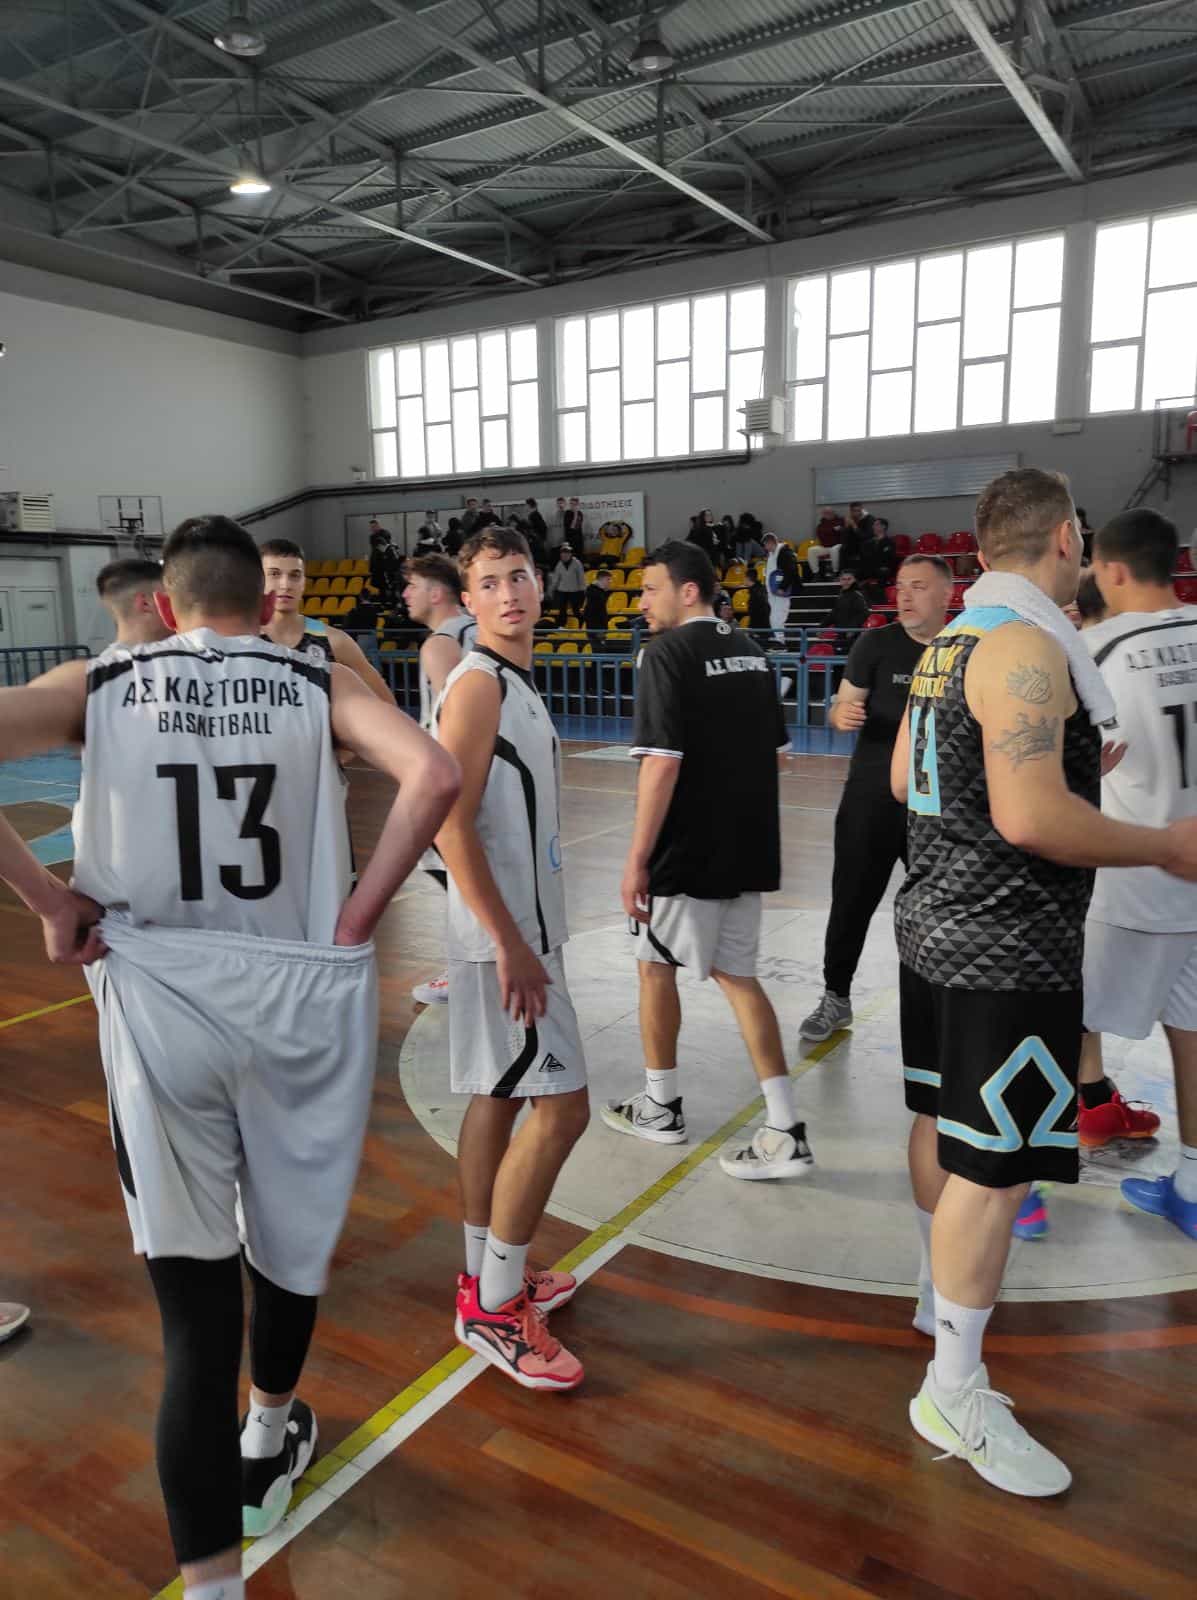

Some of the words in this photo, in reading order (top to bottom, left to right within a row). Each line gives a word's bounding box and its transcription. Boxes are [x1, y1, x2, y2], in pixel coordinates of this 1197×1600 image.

[165, 676, 304, 708] ΚΑΣΤΟΡΙΑΣ
[158, 711, 273, 738] BASKETBALL
[156, 763, 282, 901] 13
